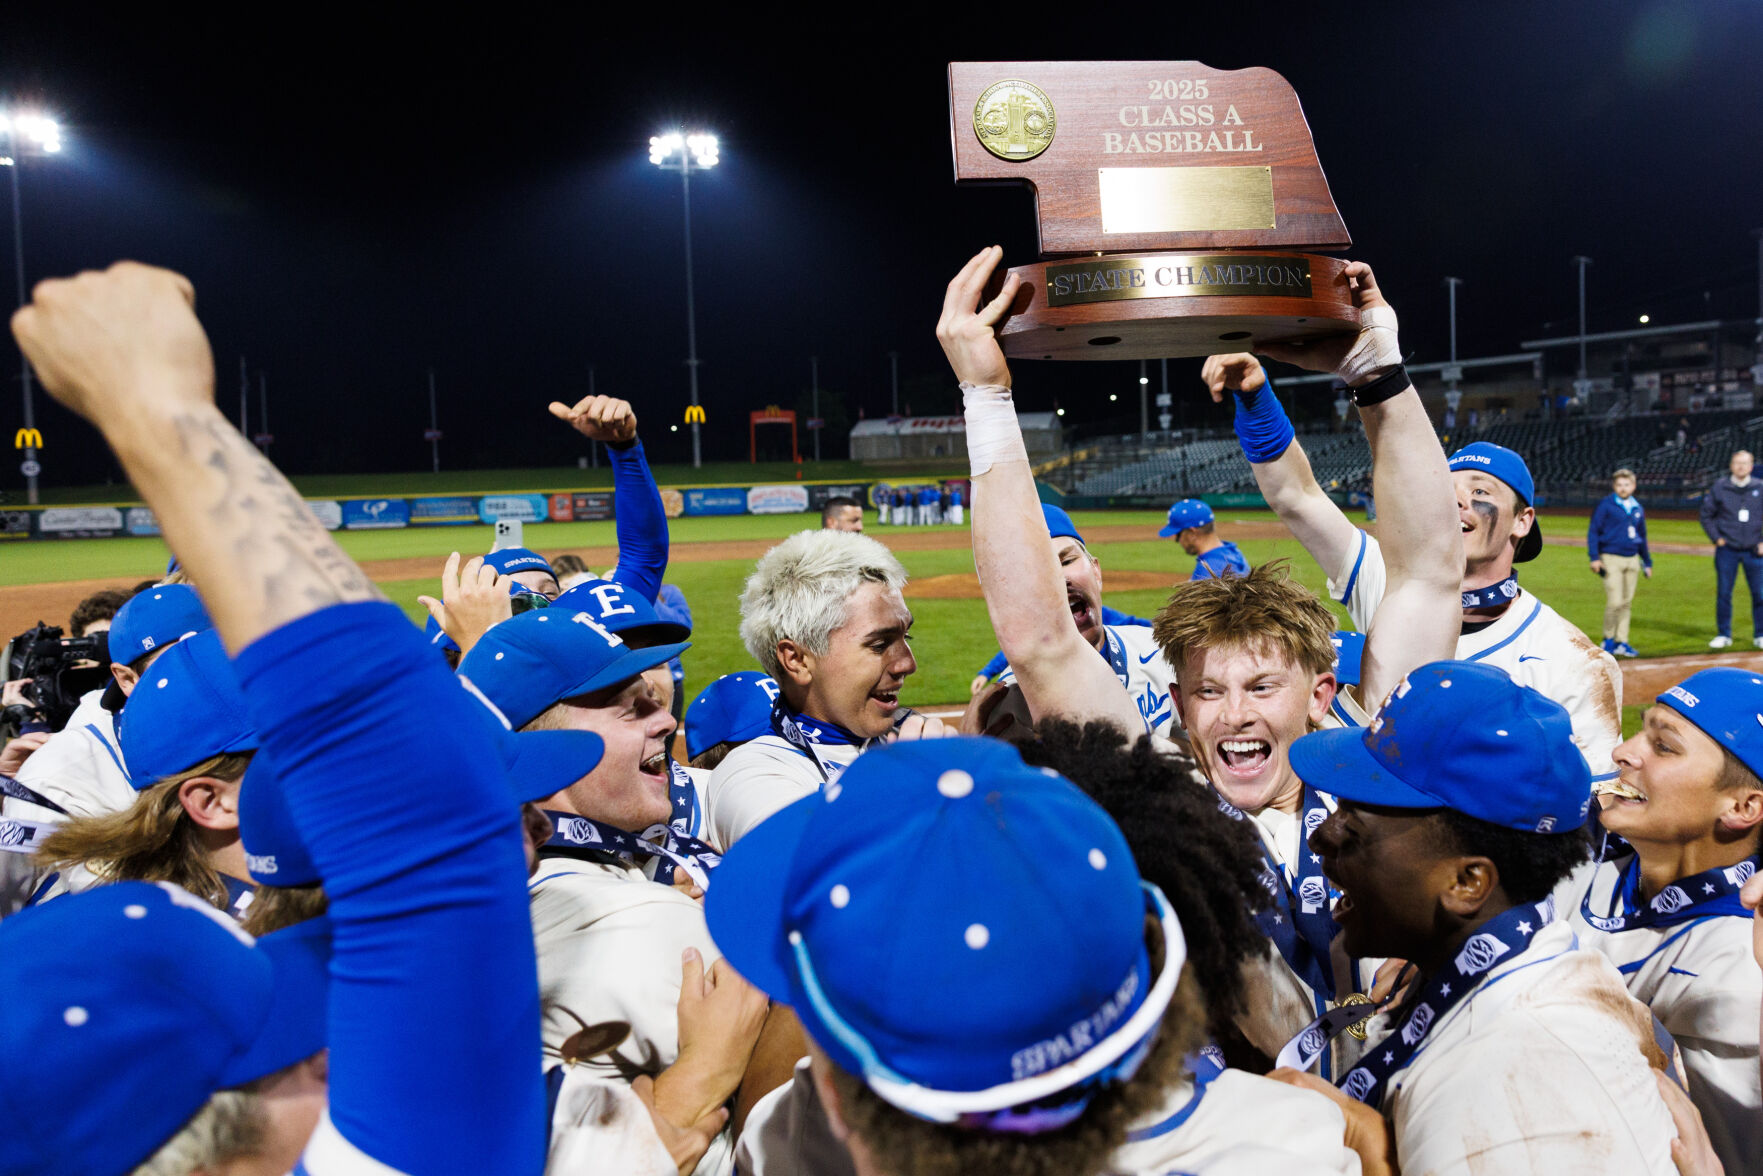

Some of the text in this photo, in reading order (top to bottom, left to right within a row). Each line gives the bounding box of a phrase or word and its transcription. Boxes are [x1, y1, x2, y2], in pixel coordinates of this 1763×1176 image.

[1148, 79, 1209, 100] 2025
[1118, 103, 1244, 127] CLASS A
[1102, 130, 1263, 154] BASEBALL
[1053, 264, 1304, 296] STATE CHAMPION
[589, 583, 636, 618] E
